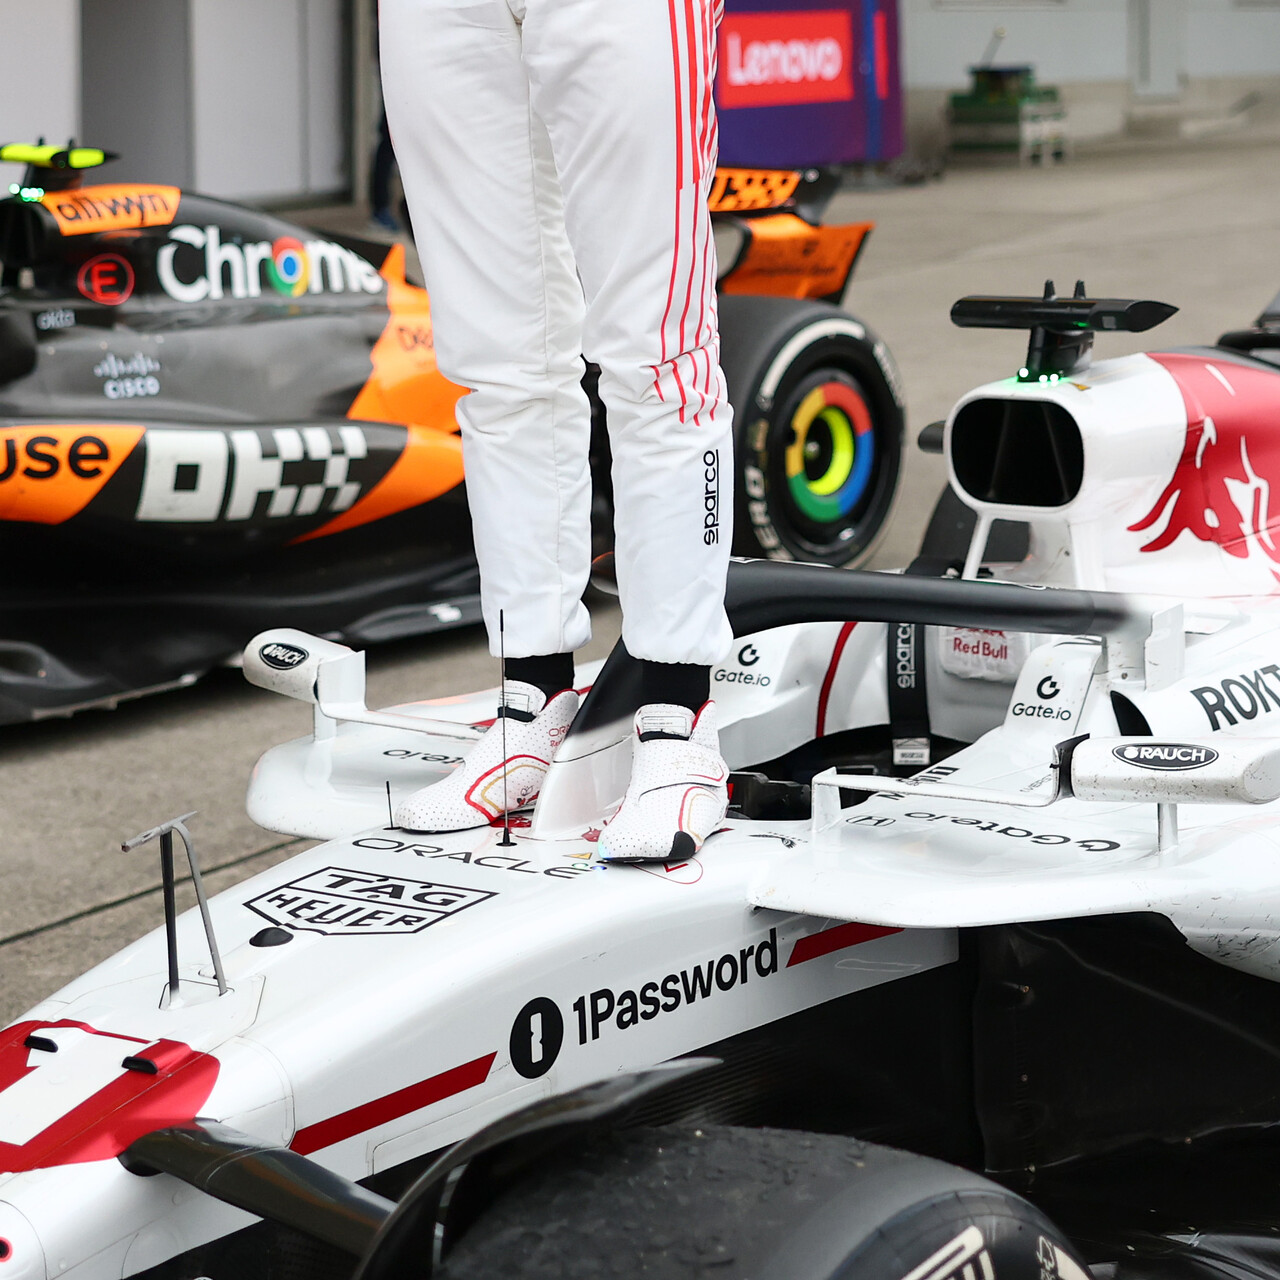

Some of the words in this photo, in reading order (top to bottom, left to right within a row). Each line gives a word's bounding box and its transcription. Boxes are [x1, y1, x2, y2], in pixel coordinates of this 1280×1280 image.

[727, 32, 842, 86] Lenovo
[90, 261, 119, 301] E
[702, 449, 719, 546] sparco
[896, 623, 915, 689] sparc
[953, 637, 980, 655] Red
[983, 641, 1008, 660] Bull
[713, 667, 771, 689] Gate.io
[1012, 702, 1072, 722] Gate.io
[1139, 744, 1207, 764] RAUCH
[904, 811, 1072, 846] Gate.io
[352, 835, 581, 880] ORACLE
[320, 872, 469, 907] TAG
[265, 891, 428, 929] HEUER
[572, 927, 779, 1046] 1Password
